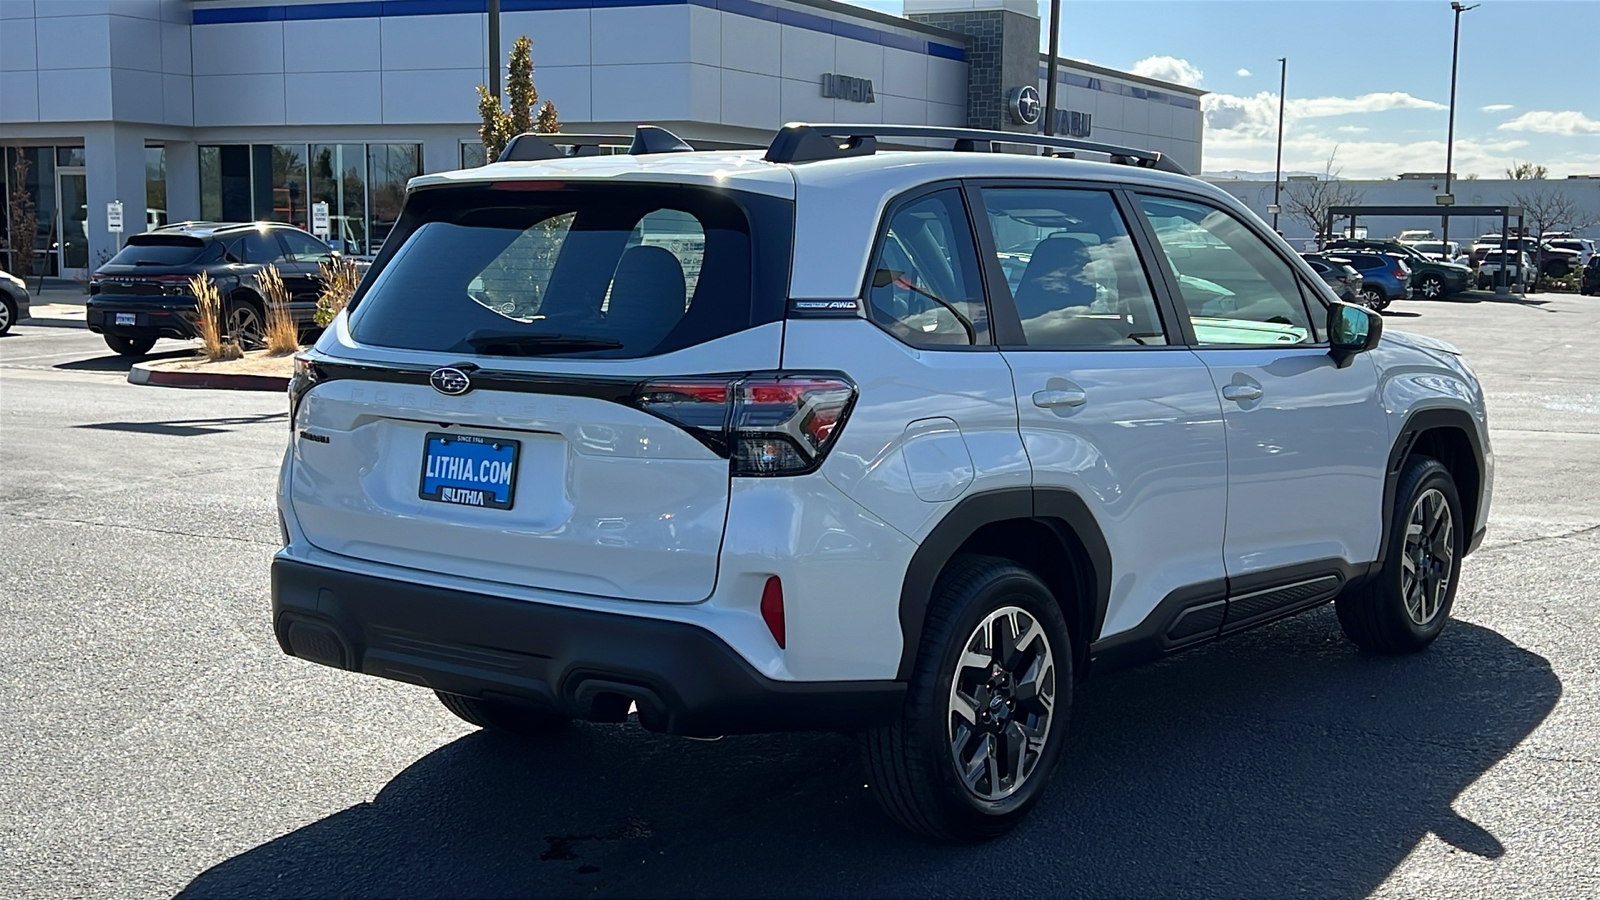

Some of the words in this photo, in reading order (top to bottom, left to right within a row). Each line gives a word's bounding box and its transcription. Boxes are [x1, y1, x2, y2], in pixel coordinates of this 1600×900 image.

[821, 73, 875, 103] LITHIA
[828, 301, 857, 309] AWD
[457, 435, 472, 443] SINCE
[426, 454, 512, 485] LITHIA.COM
[451, 488, 484, 506] LITHIA
